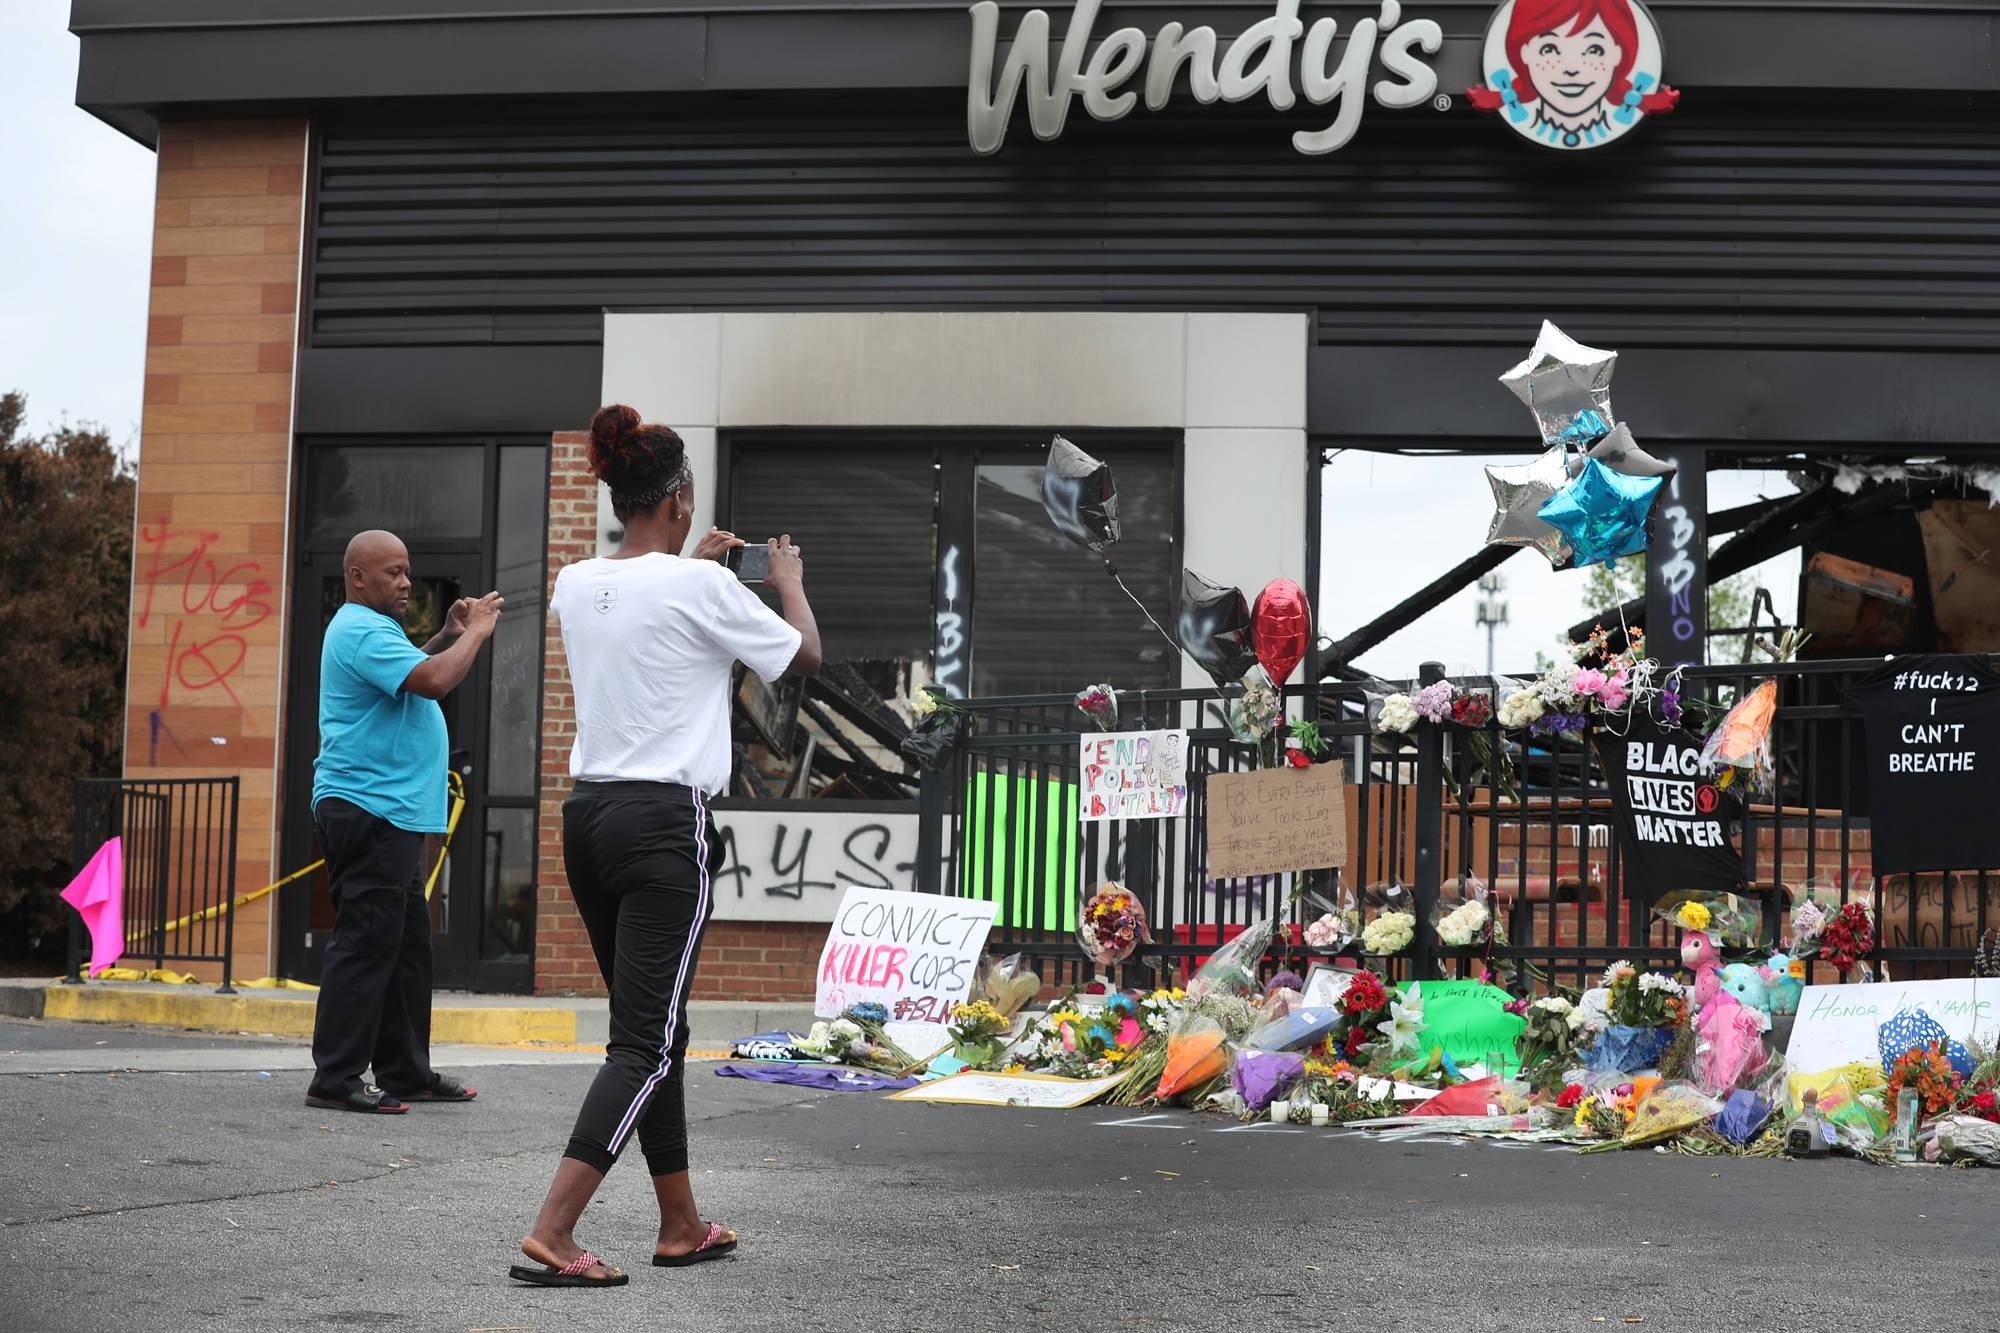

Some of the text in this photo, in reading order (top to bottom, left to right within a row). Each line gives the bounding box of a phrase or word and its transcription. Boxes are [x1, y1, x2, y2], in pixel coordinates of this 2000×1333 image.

[968, 0, 1441, 153] Wendy's
[1930, 697, 1937, 716] I
[1901, 724, 1965, 744] CAN'T
[1095, 737, 1152, 766] END
[1889, 751, 1976, 773] BREATHE
[1085, 763, 1174, 792] POLICE
[1628, 779, 1695, 812] LIVES
[1634, 814, 1725, 848] MATTER
[1891, 876, 1956, 914] BACK
[840, 901, 992, 951] CONVICT
[822, 941, 971, 992] KILLER COPS
[1808, 992, 1884, 1020] HONOR
